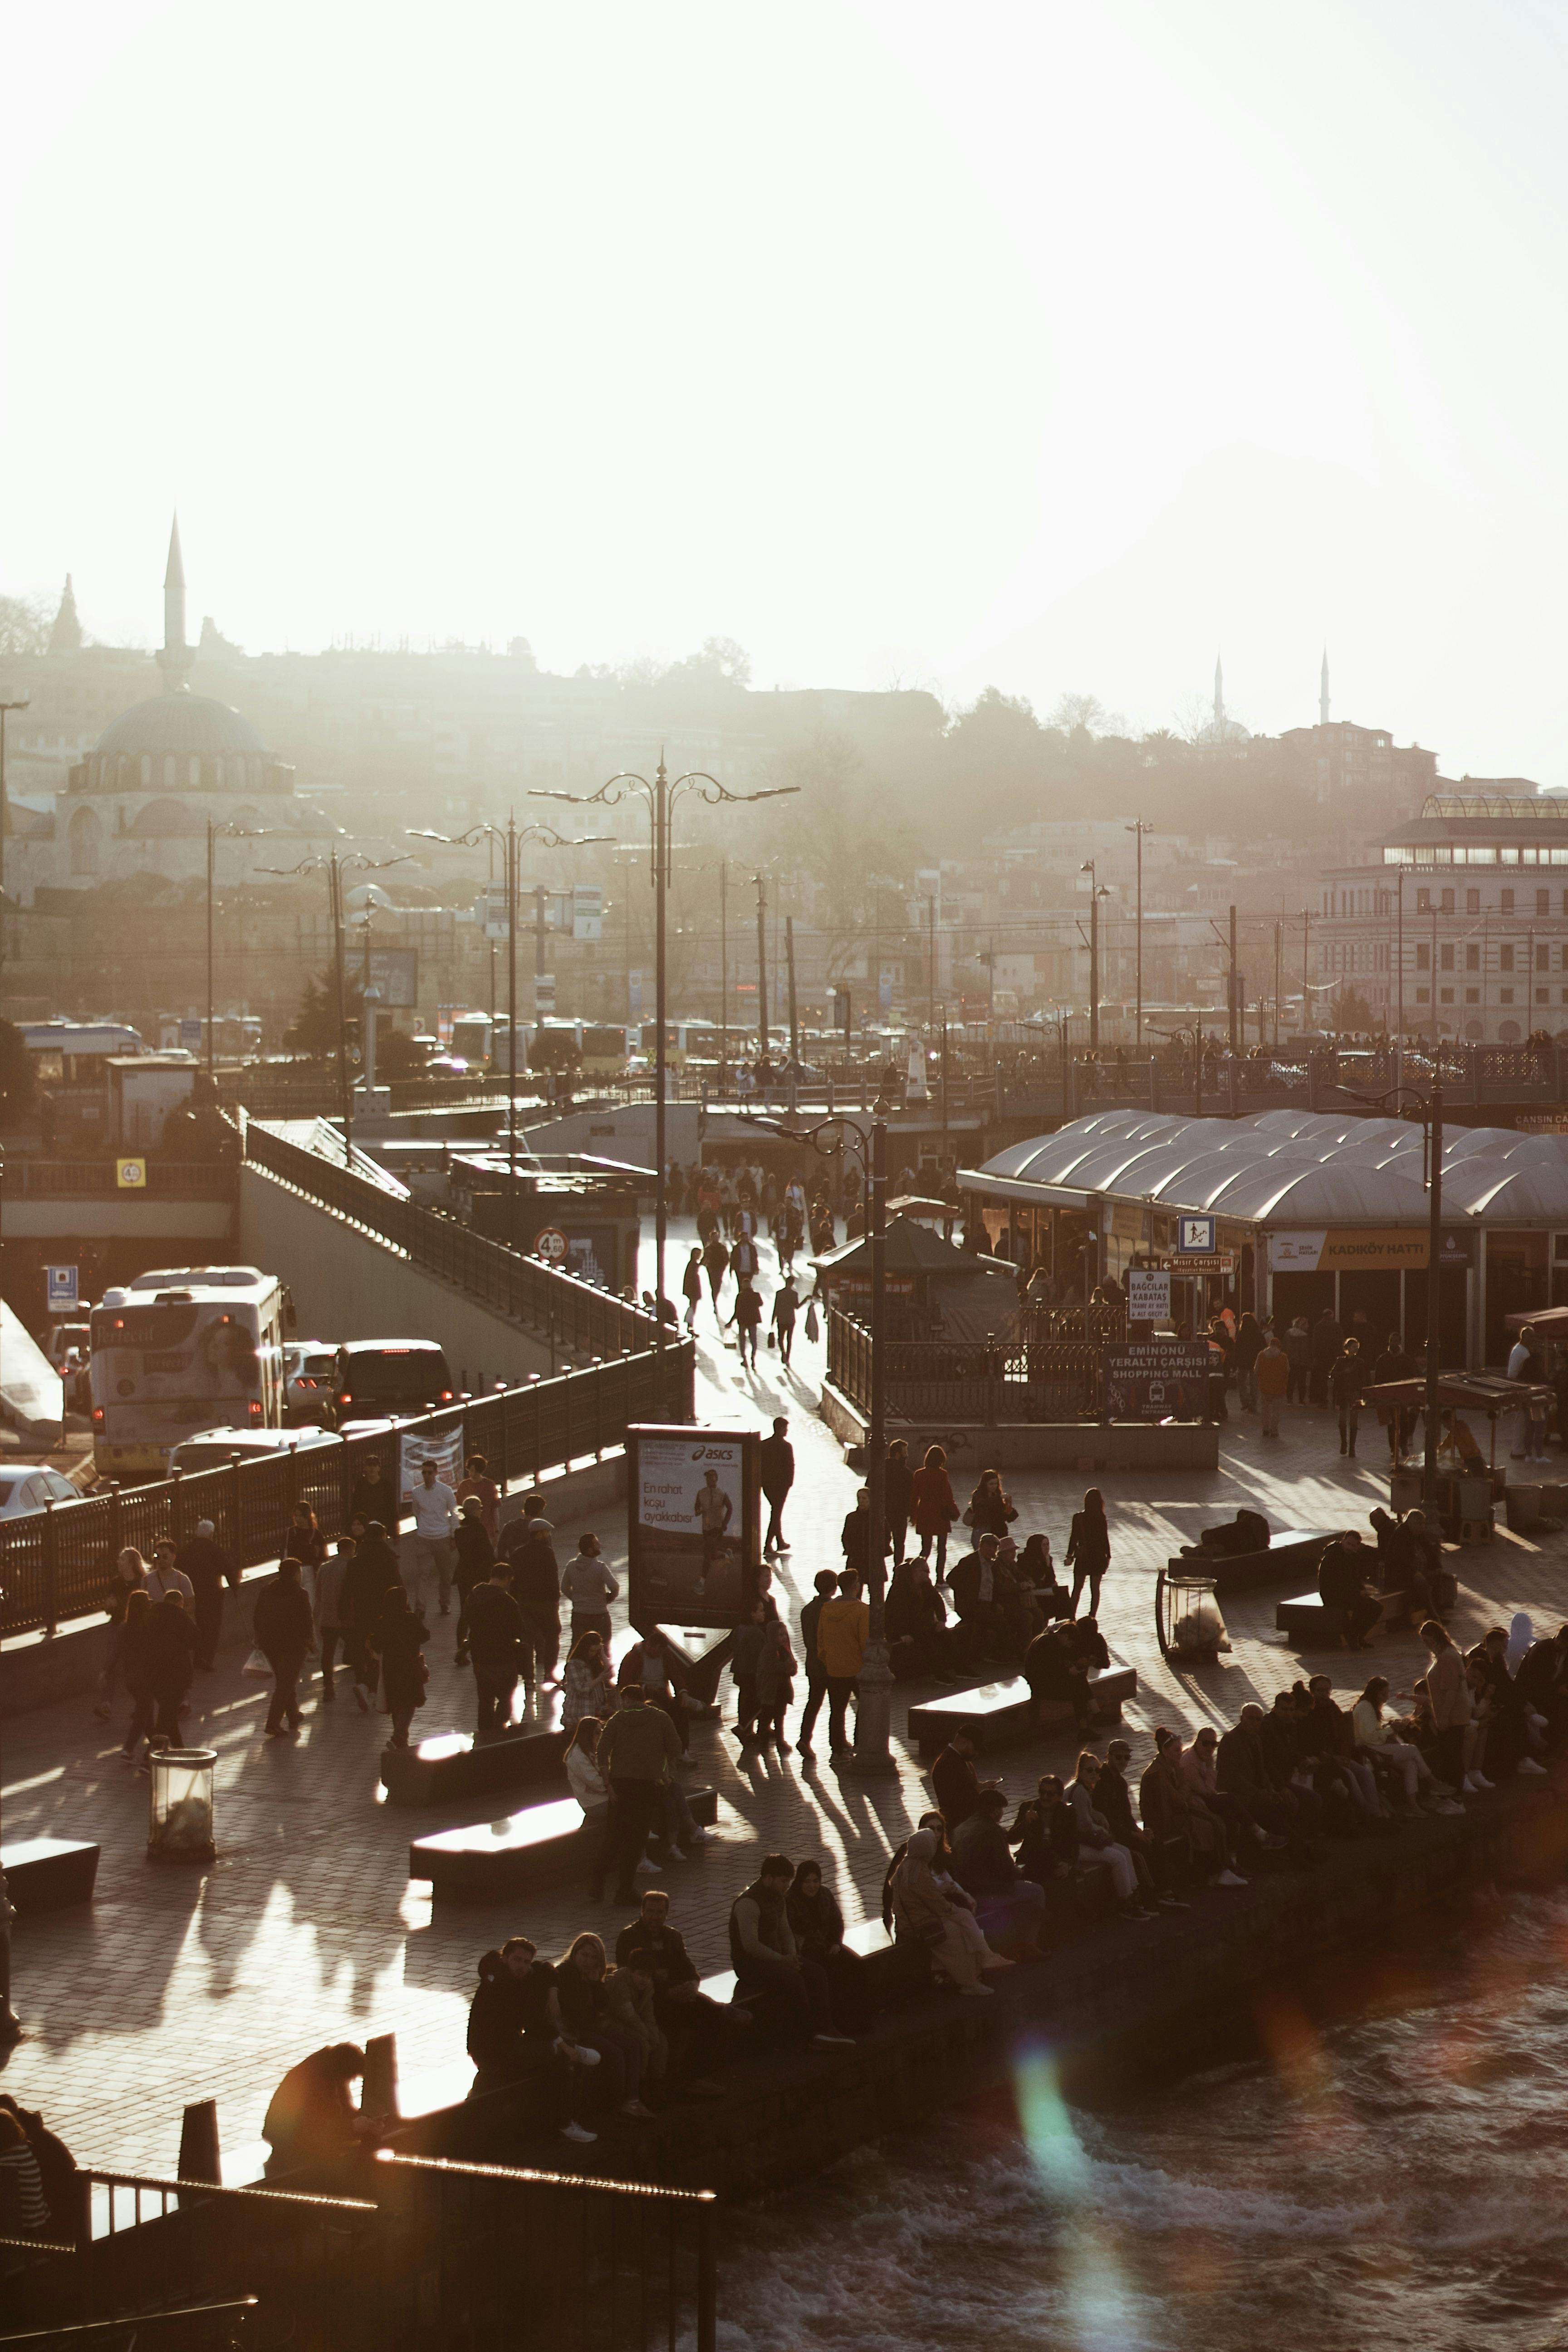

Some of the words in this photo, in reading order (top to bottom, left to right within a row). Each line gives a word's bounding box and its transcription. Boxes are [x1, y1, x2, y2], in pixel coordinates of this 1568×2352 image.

[1516, 1116, 1553, 1124] CANSIN
[1329, 1242, 1384, 1256] KADIKÖY
[1387, 1244, 1423, 1254] HATTI
[1193, 1259, 1220, 1267] Çarşısı
[1132, 1293, 1167, 1302] KABATAŞ
[1129, 1344, 1186, 1356] EMİNÖNÜ
[1109, 1358, 1156, 1367] YERALTI
[1161, 1357, 1206, 1369] ÇARŞISI
[1112, 1370, 1169, 1379] SHOPPING
[1172, 1370, 1201, 1378] MALL
[706, 1449, 733, 1460] asics
[644, 1482, 656, 1494] En
[658, 1483, 683, 1495] rahat
[644, 1496, 666, 1510] koşu
[644, 1511, 693, 1524] ayakkabısı
